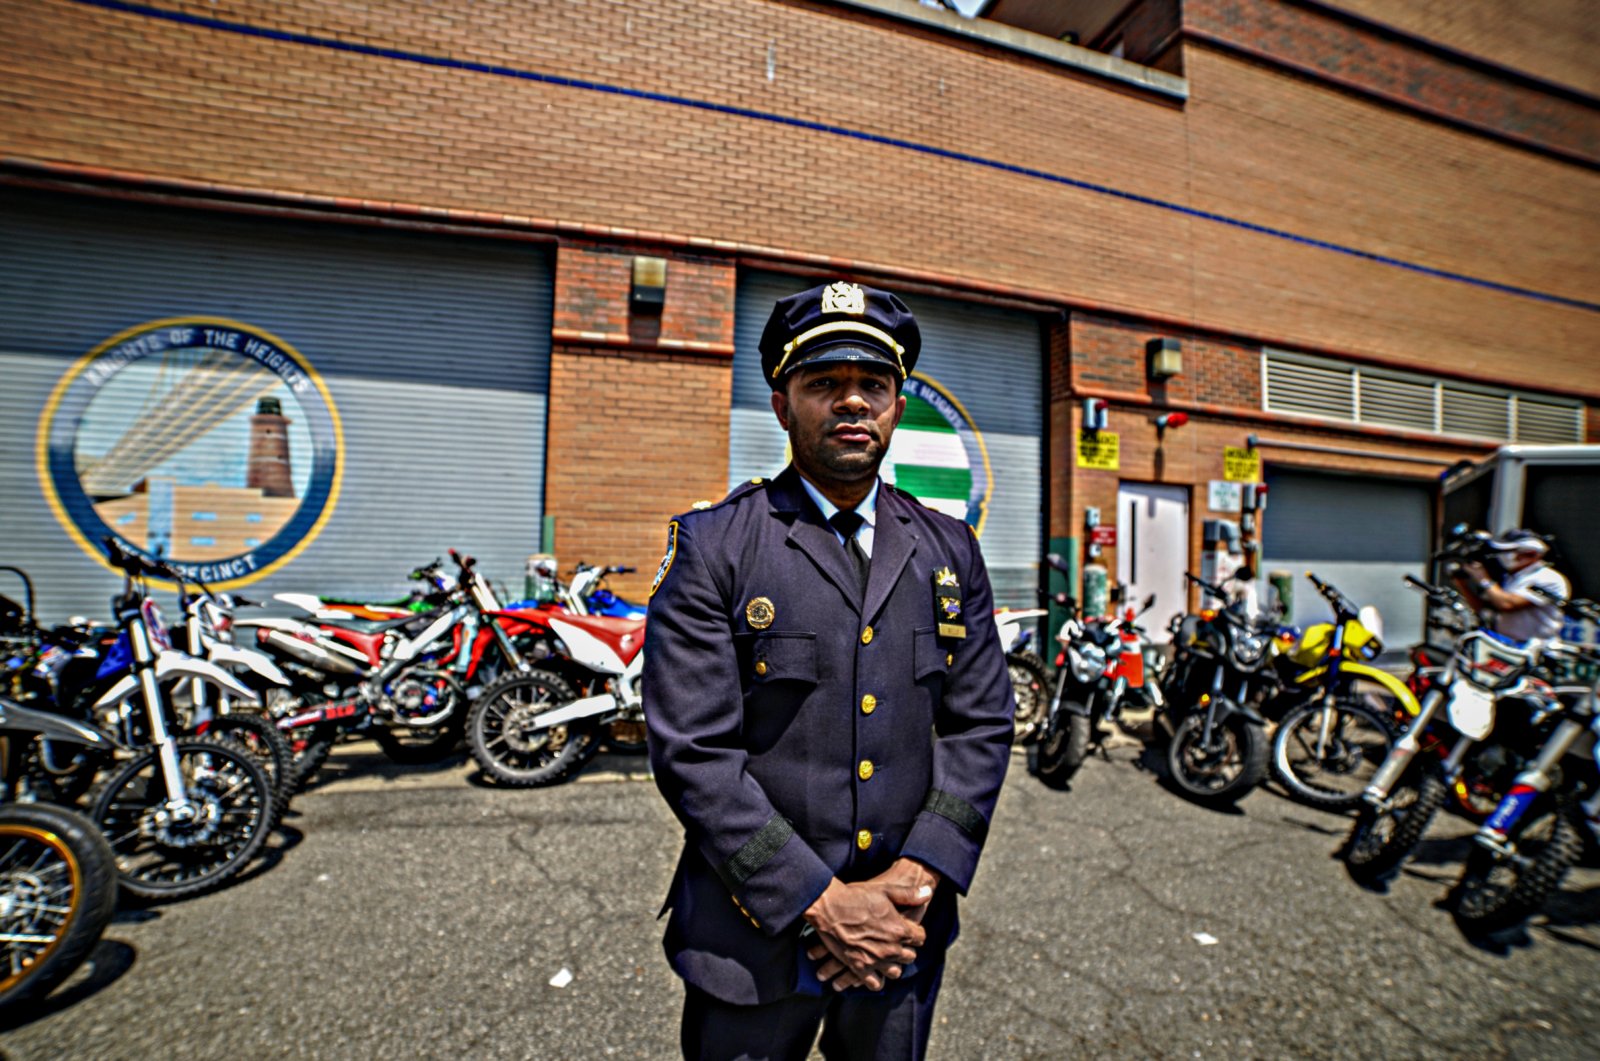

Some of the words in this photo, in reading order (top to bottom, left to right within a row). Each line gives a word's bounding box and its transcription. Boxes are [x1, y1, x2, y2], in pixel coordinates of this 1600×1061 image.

[169, 329, 193, 345] OF
[203, 329, 240, 349] THE
[244, 338, 309, 393] HEIGHTS
